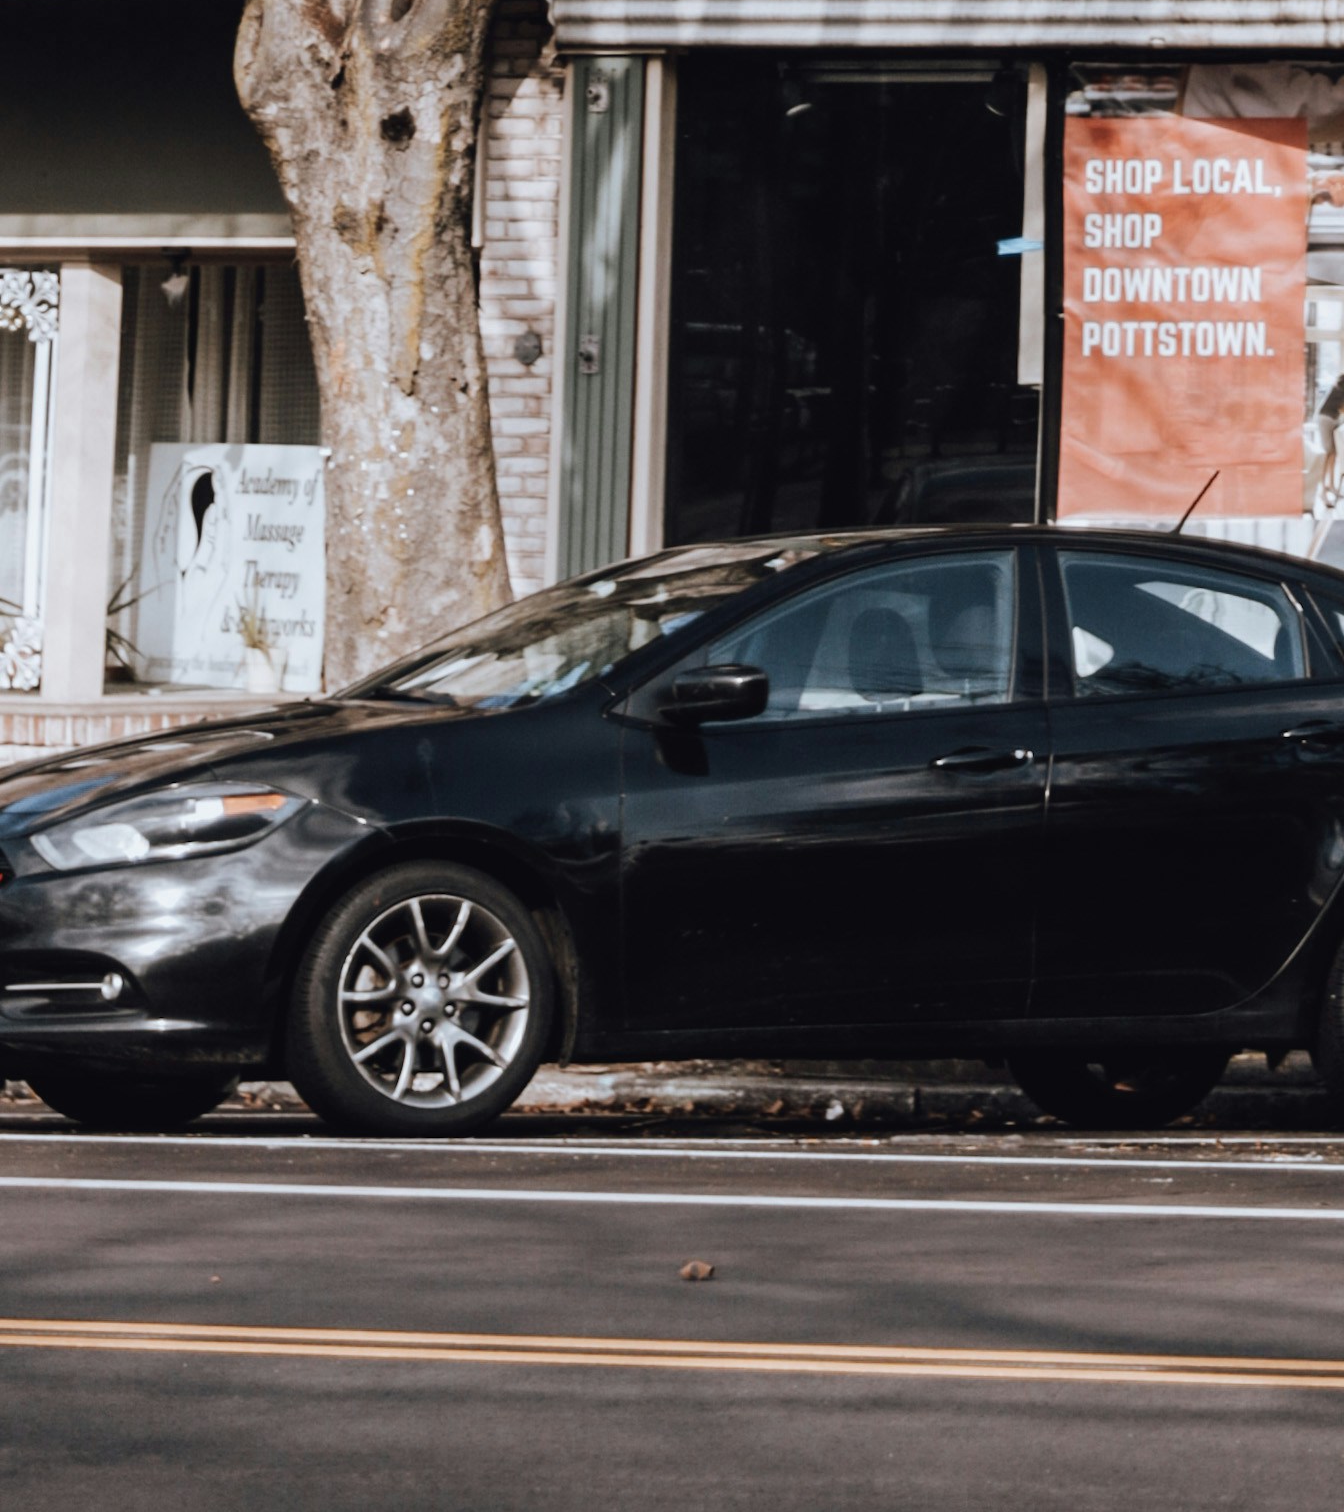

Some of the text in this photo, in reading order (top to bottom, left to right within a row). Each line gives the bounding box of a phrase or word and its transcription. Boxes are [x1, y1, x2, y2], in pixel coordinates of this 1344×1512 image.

[1085, 158, 1284, 198] SHOP LOCAL,
[1083, 212, 1163, 249] SHOP
[1082, 266, 1263, 303] DOWNTOWN
[1081, 320, 1276, 358] POTTSTOWN.
[235, 466, 322, 506] Academy of
[243, 512, 306, 553] Massage
[244, 559, 301, 600] Therapy
